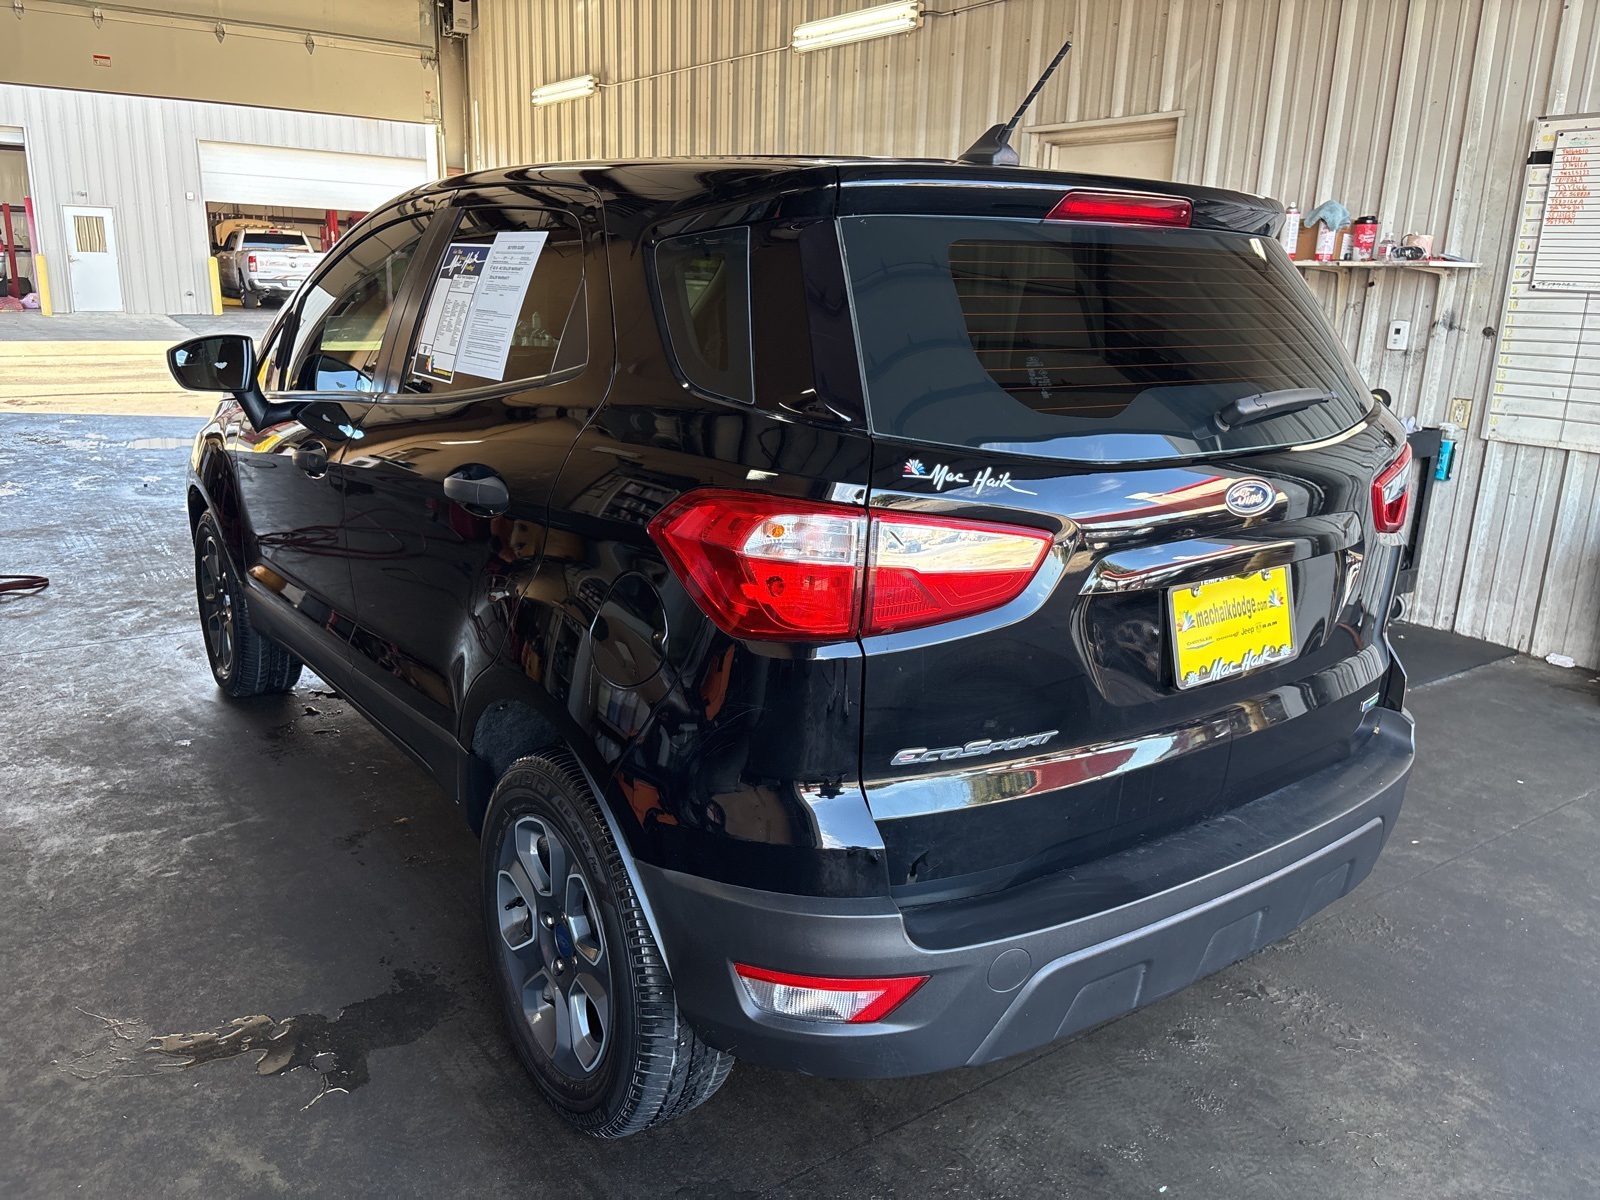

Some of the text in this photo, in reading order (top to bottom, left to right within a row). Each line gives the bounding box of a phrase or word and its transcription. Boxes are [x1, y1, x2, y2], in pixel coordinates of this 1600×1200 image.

[1512, 286, 1517, 295] 9
[1508, 301, 1516, 309] 10
[1506, 315, 1514, 324] 11
[1504, 329, 1513, 337] 12
[1501, 342, 1510, 351] 13
[1500, 356, 1508, 365] 14
[1497, 370, 1506, 379] 15
[1495, 384, 1504, 393] 16
[1492, 399, 1501, 408] 17
[1490, 416, 1498, 425] 18
[925, 463, 1036, 495] Mac Haik
[1231, 486, 1264, 507] Ford
[1195, 595, 1268, 628] machaikdodge.com
[1187, 636, 1213, 646] CHRYSLER
[1241, 626, 1255, 636] Jeep
[1209, 645, 1281, 681] Mac Haik
